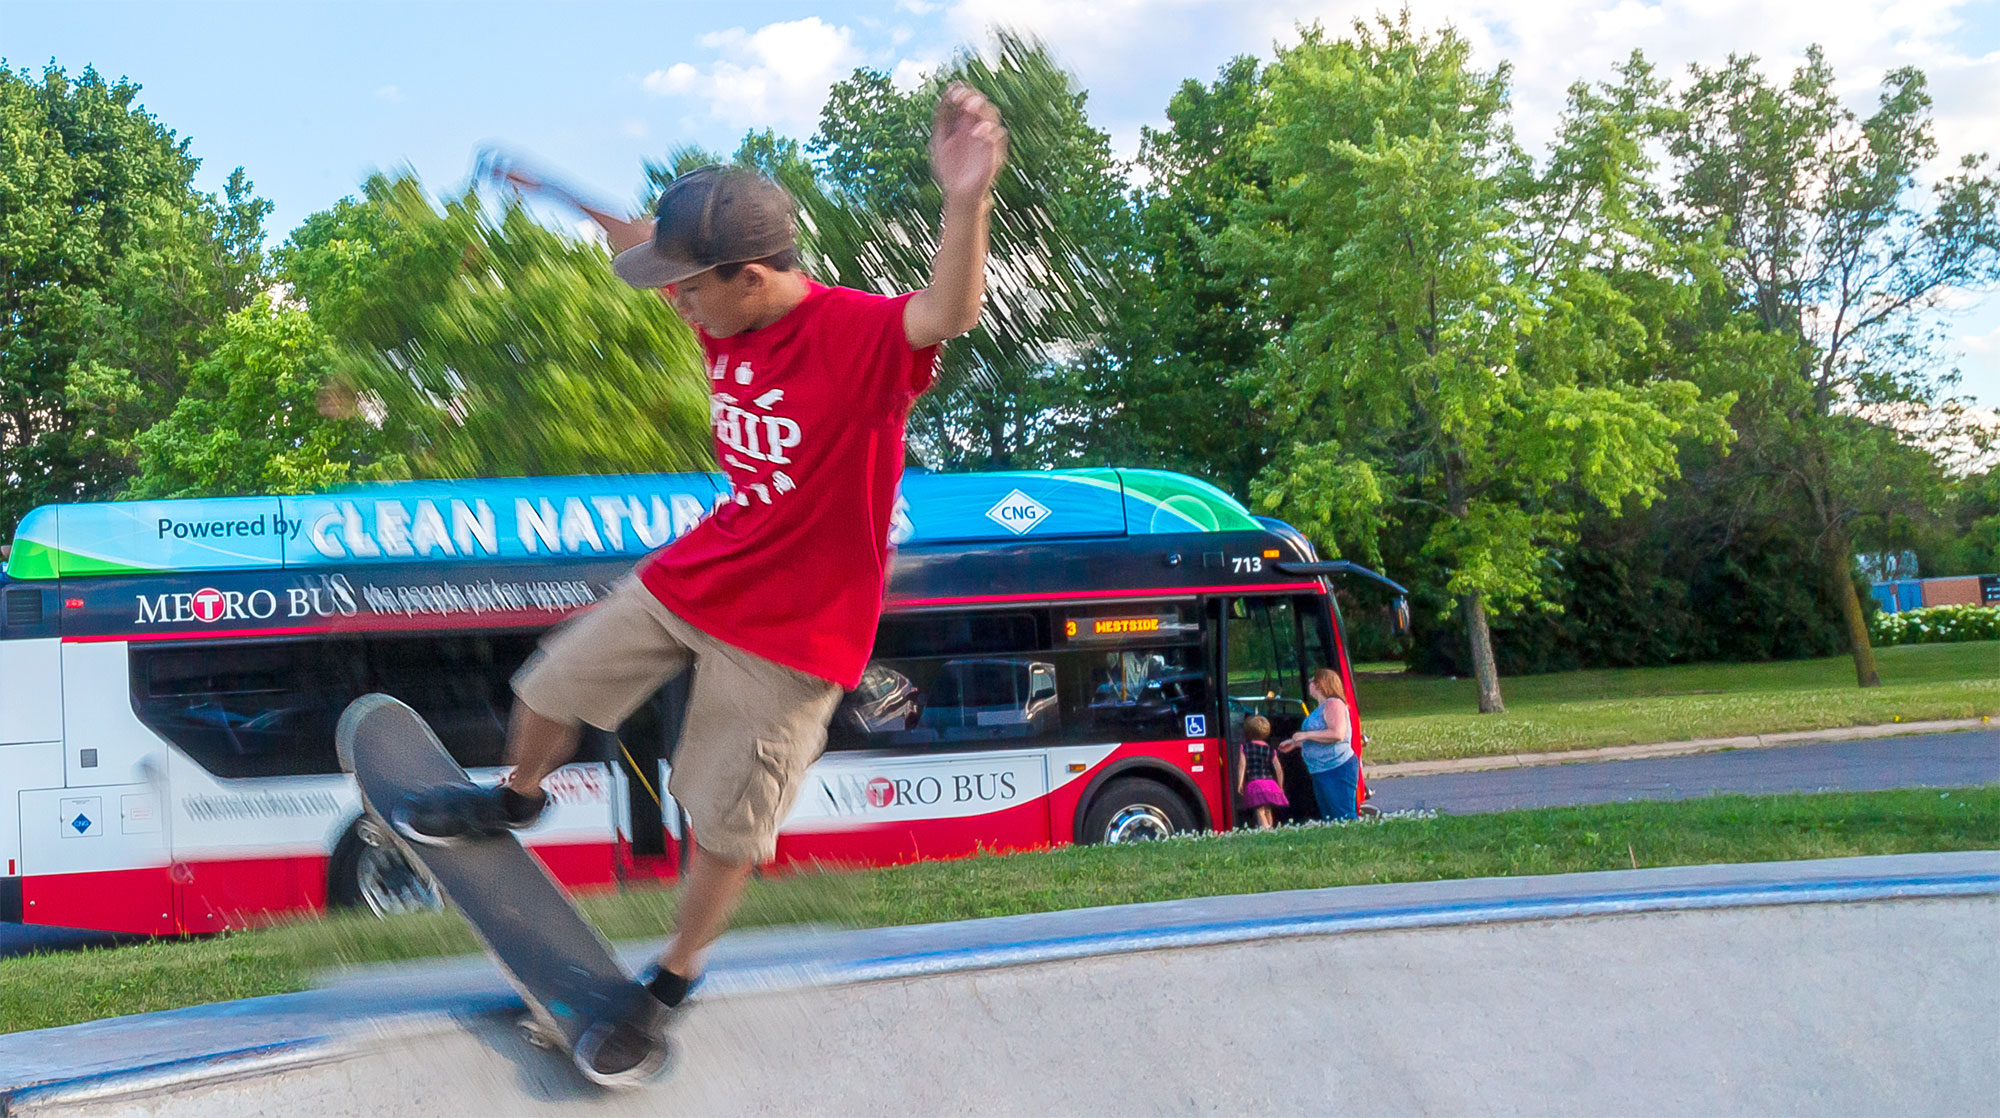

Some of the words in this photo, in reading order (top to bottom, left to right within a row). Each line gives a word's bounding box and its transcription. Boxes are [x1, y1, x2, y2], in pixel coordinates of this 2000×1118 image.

[158, 514, 265, 539] Powered
[273, 514, 301, 541] by
[312, 498, 498, 556] CLEAN
[515, 492, 730, 553] NATUR
[1001, 505, 1036, 521] CNG
[1232, 557, 1261, 573] 713
[135, 587, 277, 624] METRO
[287, 573, 358, 617] BUS
[362, 582, 401, 615] the
[397, 580, 469, 619] people
[1066, 621, 1077, 637] 3
[1095, 618, 1159, 634] WESTSIDE
[952, 771, 1017, 803] BUS
